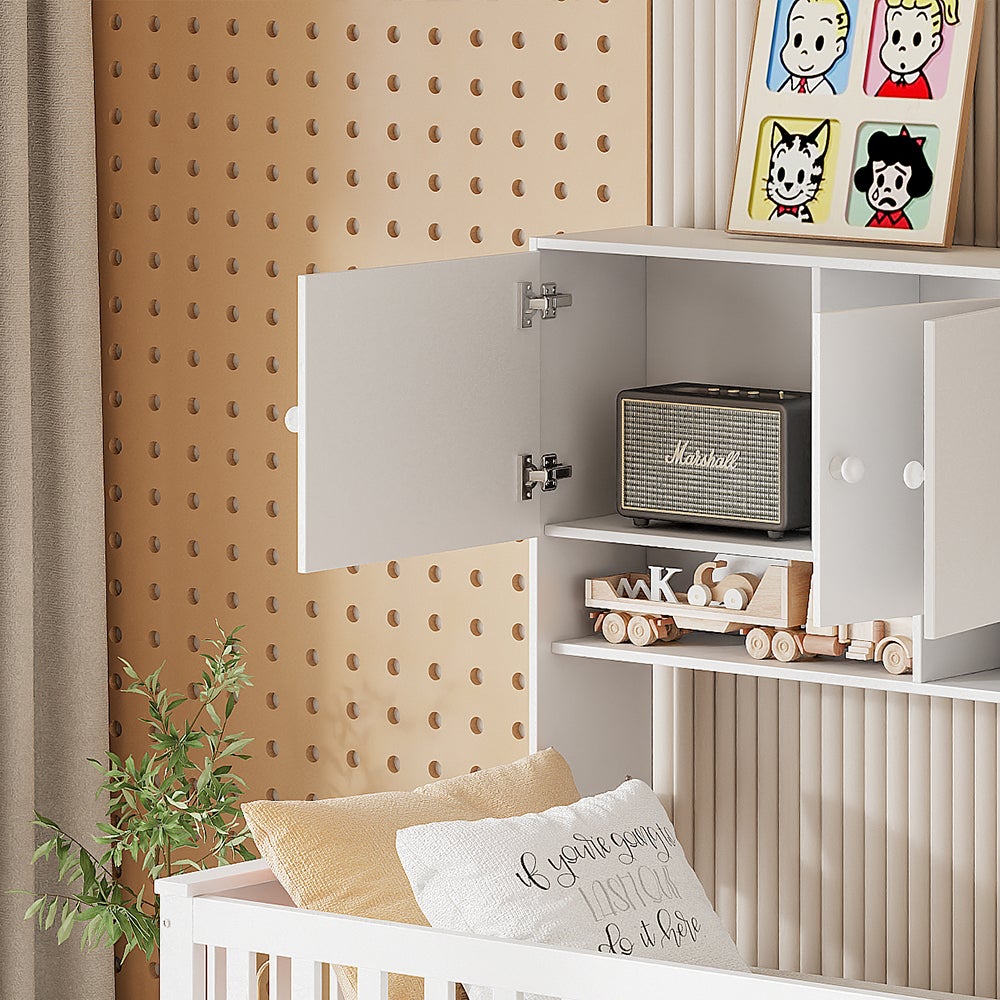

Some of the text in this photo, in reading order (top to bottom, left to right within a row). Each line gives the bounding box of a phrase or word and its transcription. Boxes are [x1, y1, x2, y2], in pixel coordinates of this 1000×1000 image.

[665, 440, 741, 470] Marshall
[648, 565, 683, 604] K
[515, 851, 551, 891] if
[639, 920, 656, 948] it
[657, 908, 702, 949] here
